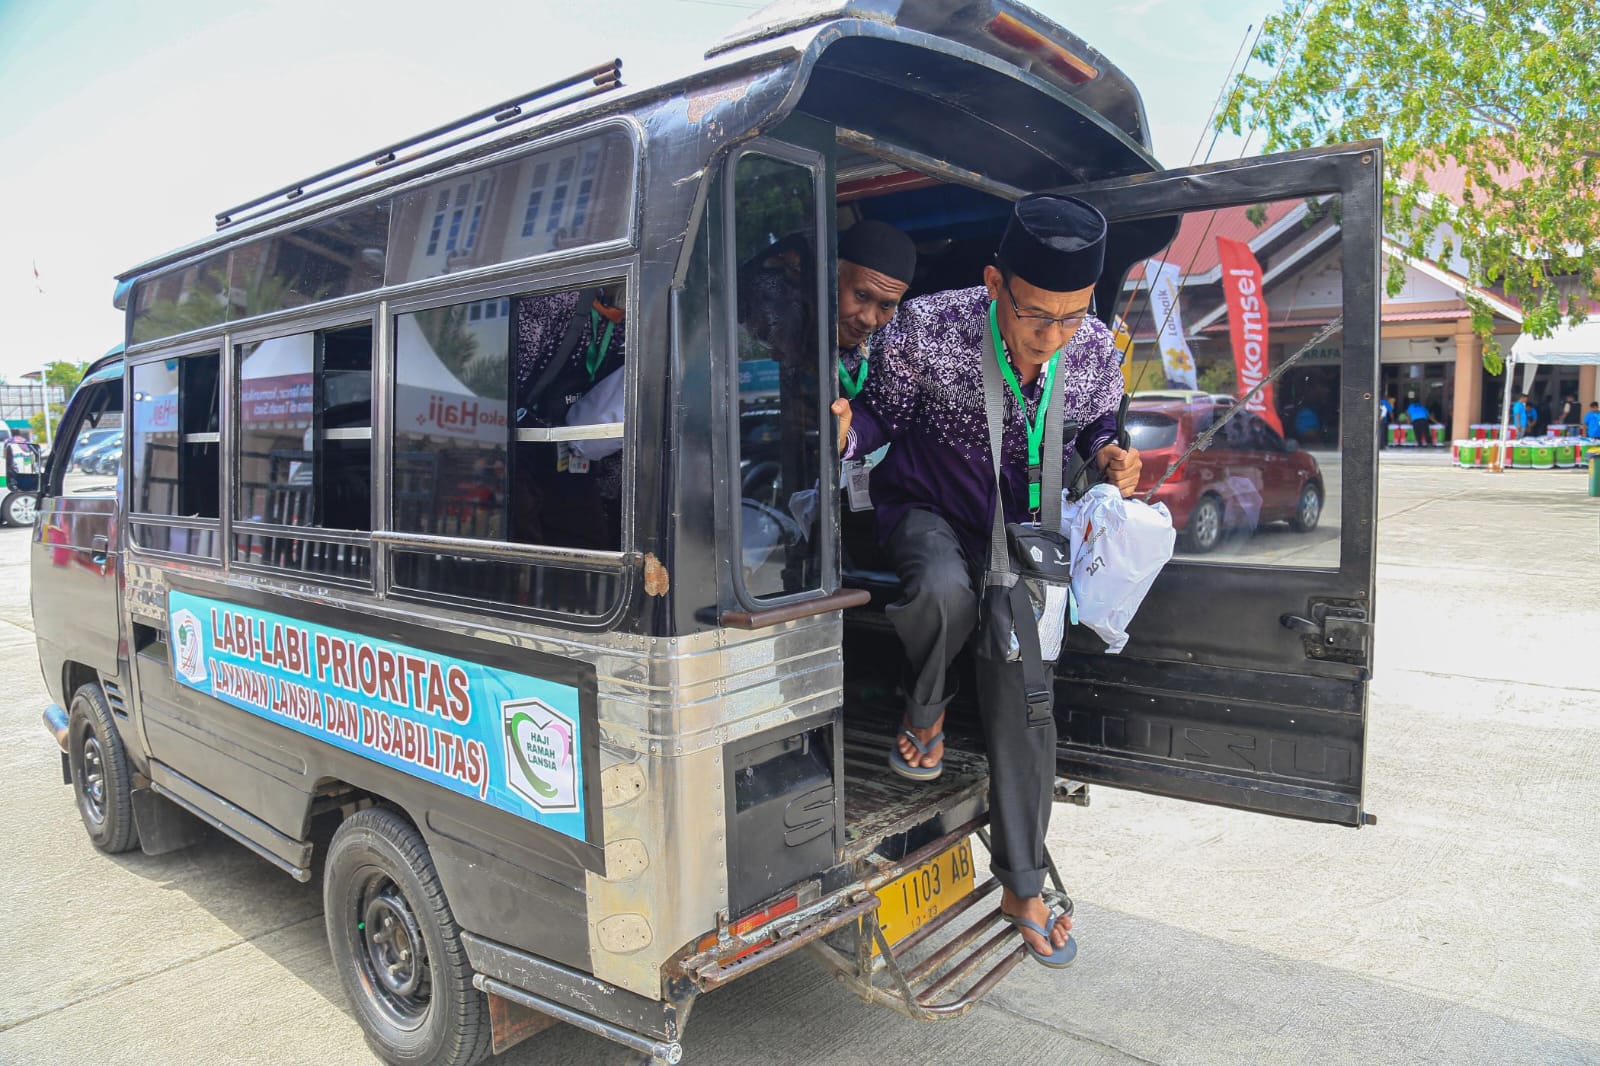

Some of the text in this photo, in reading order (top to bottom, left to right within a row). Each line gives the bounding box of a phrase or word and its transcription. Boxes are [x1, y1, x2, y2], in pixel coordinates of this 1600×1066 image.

[1086, 556, 1107, 577] 207
[211, 609, 470, 722] LABI-LABI PRIORITAS
[271, 678, 322, 729] LANSIA
[325, 696, 359, 740] DAN
[363, 707, 488, 798] DISABILITAS)
[530, 731, 550, 746] HAJI
[526, 742, 556, 760] RAMAH
[527, 753, 558, 772] LANSIA
[902, 846, 970, 915] 1103 AB
